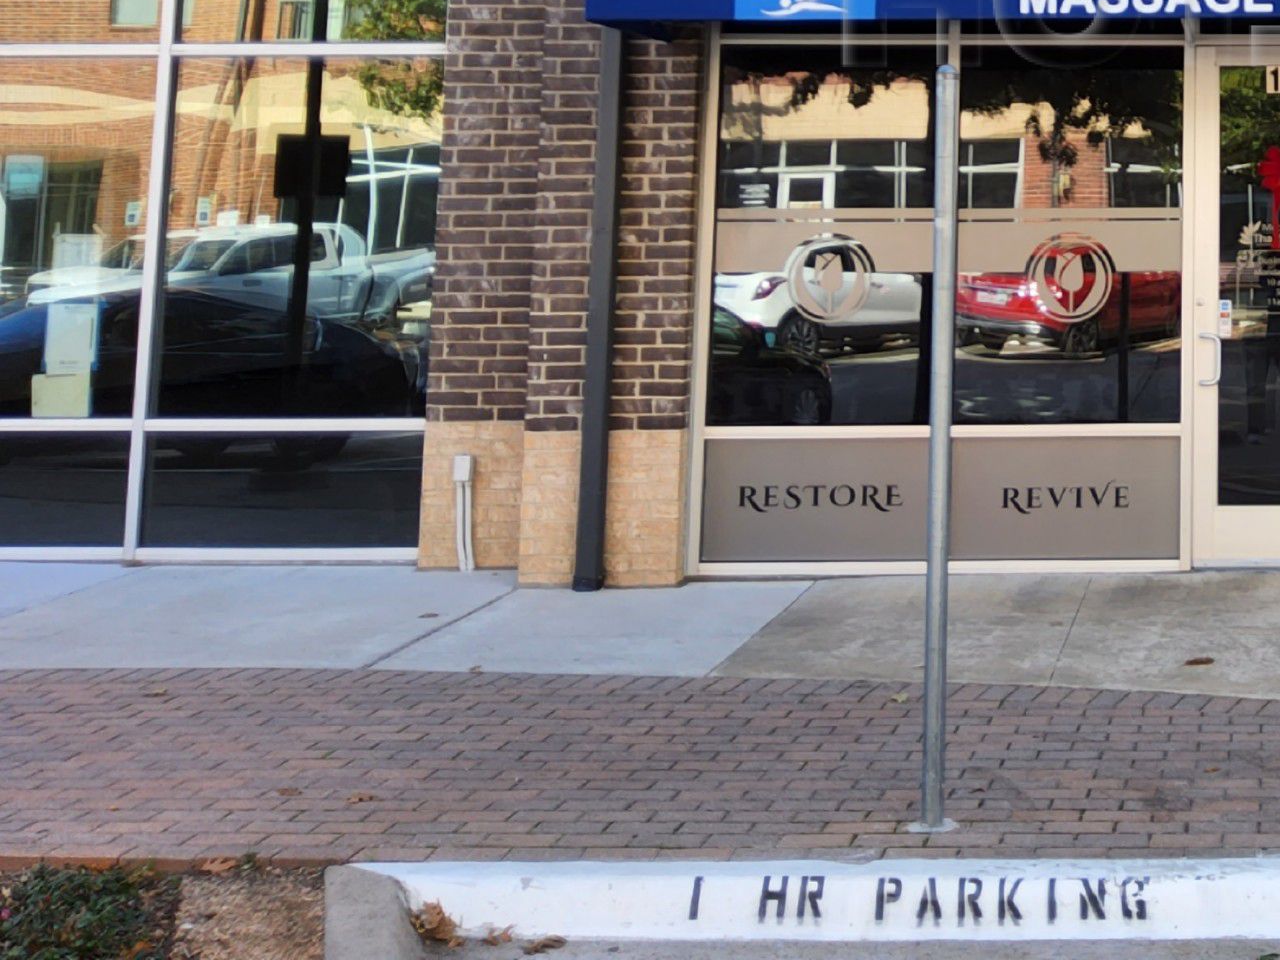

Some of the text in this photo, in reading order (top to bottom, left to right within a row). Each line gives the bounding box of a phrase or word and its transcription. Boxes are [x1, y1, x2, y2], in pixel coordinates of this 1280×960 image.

[737, 484, 904, 513] RESTORE
[1001, 479, 1131, 515] REVIVE
[757, 876, 826, 924] HR
[873, 876, 1151, 927] PARKING
